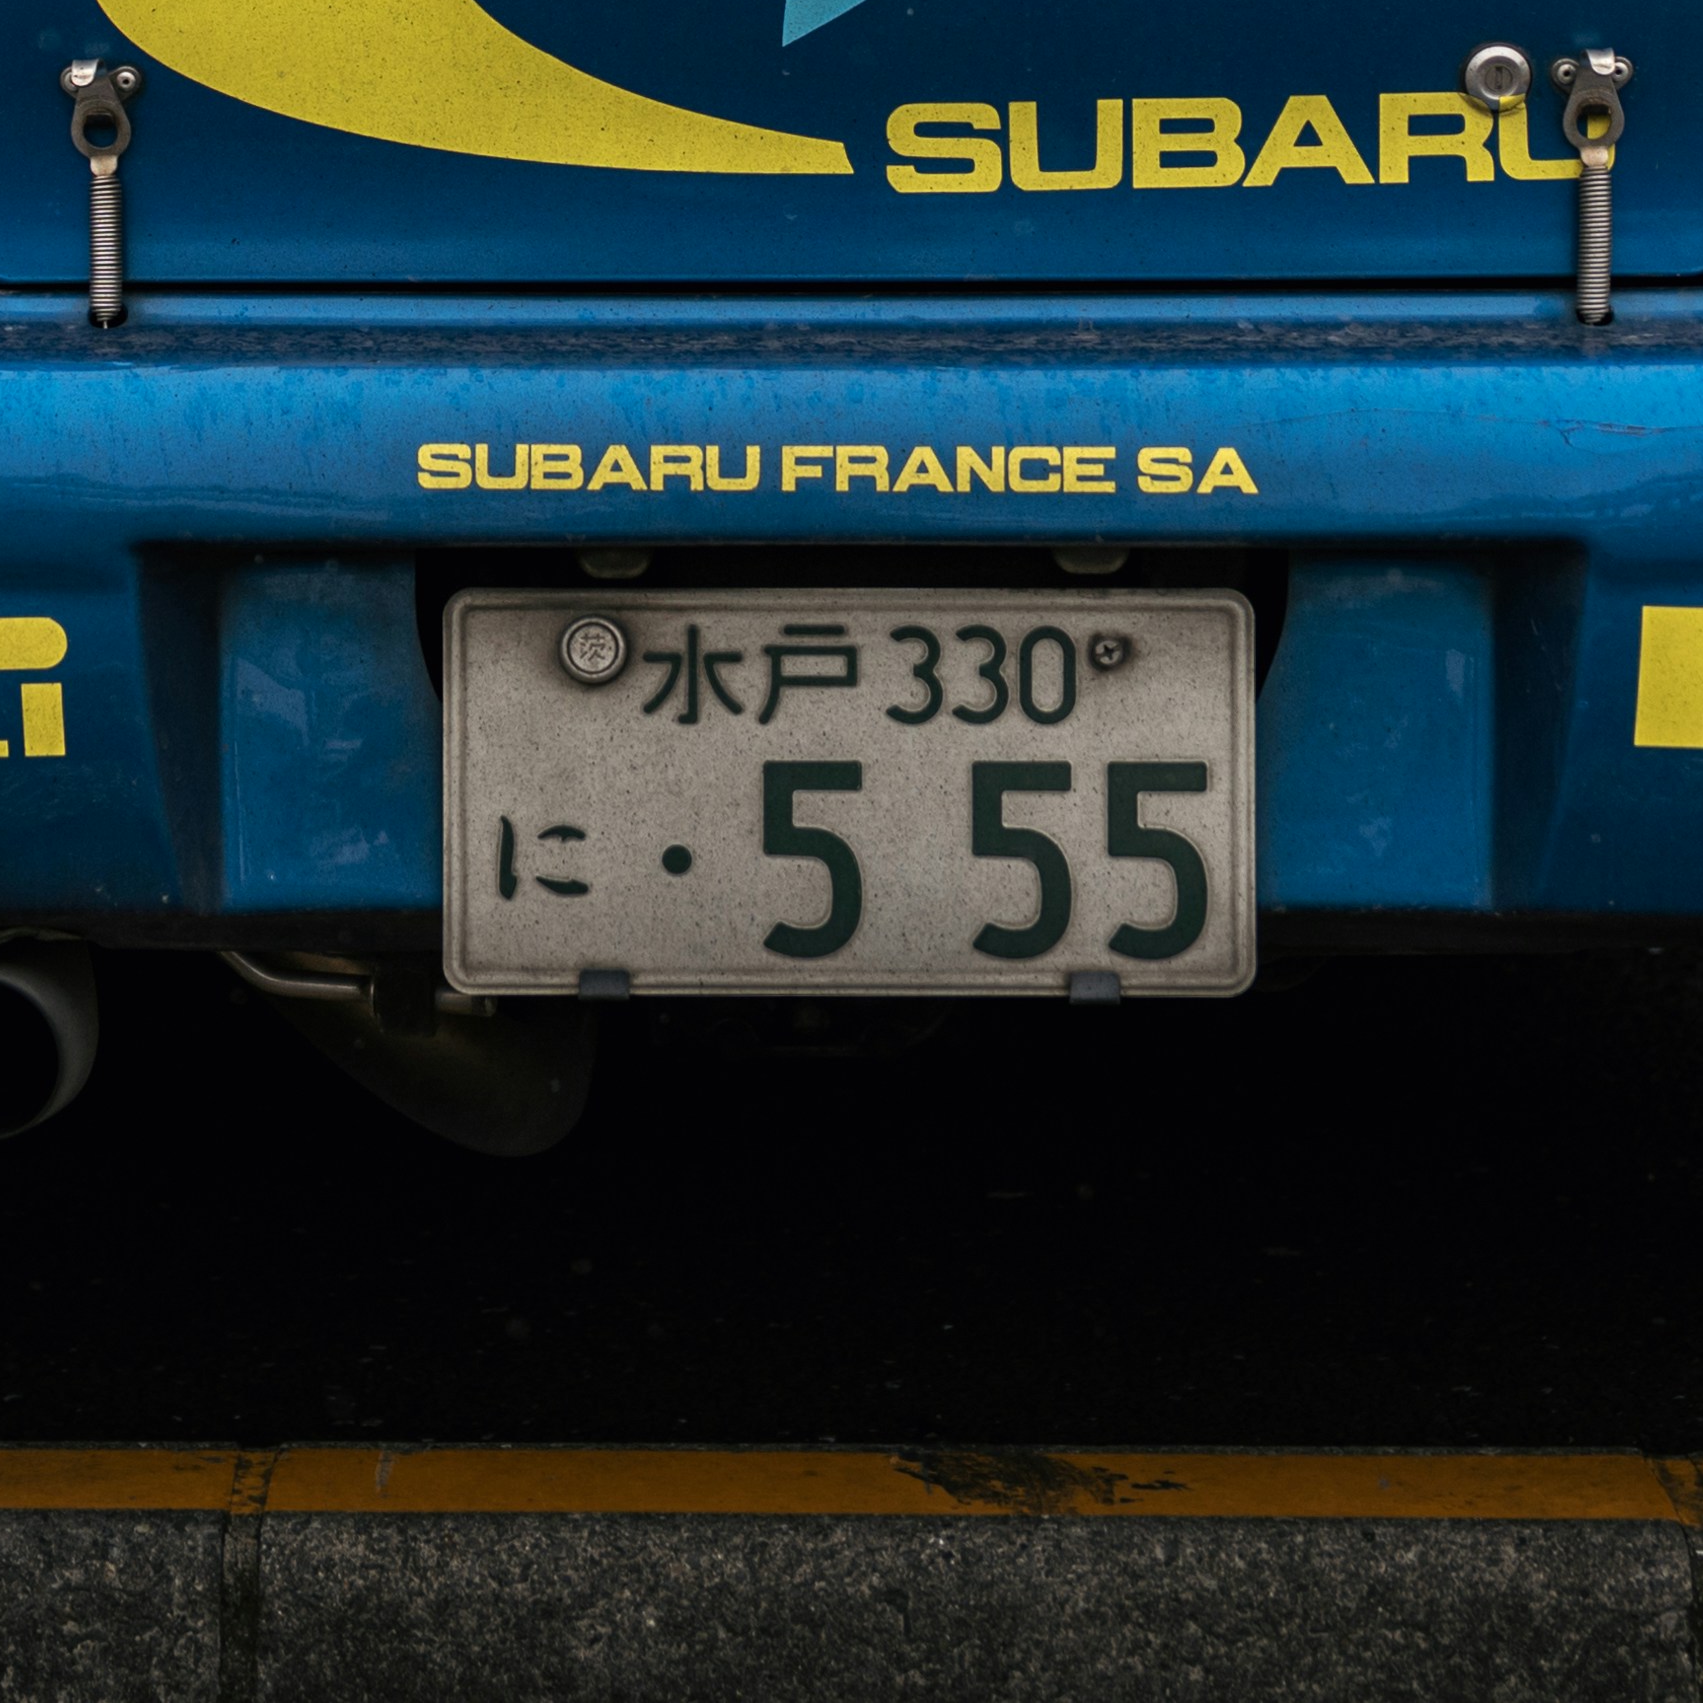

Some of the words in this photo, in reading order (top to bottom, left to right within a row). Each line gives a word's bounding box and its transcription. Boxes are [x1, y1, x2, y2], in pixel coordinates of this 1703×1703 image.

[886, 92, 1616, 193] SUBARU
[417, 443, 761, 491] SUBARU
[781, 445, 1116, 494] FRANCE
[1138, 446, 1259, 494] SA
[642, 625, 858, 725] 水戸
[885, 625, 1076, 725] 330
[498, 815, 589, 900] に
